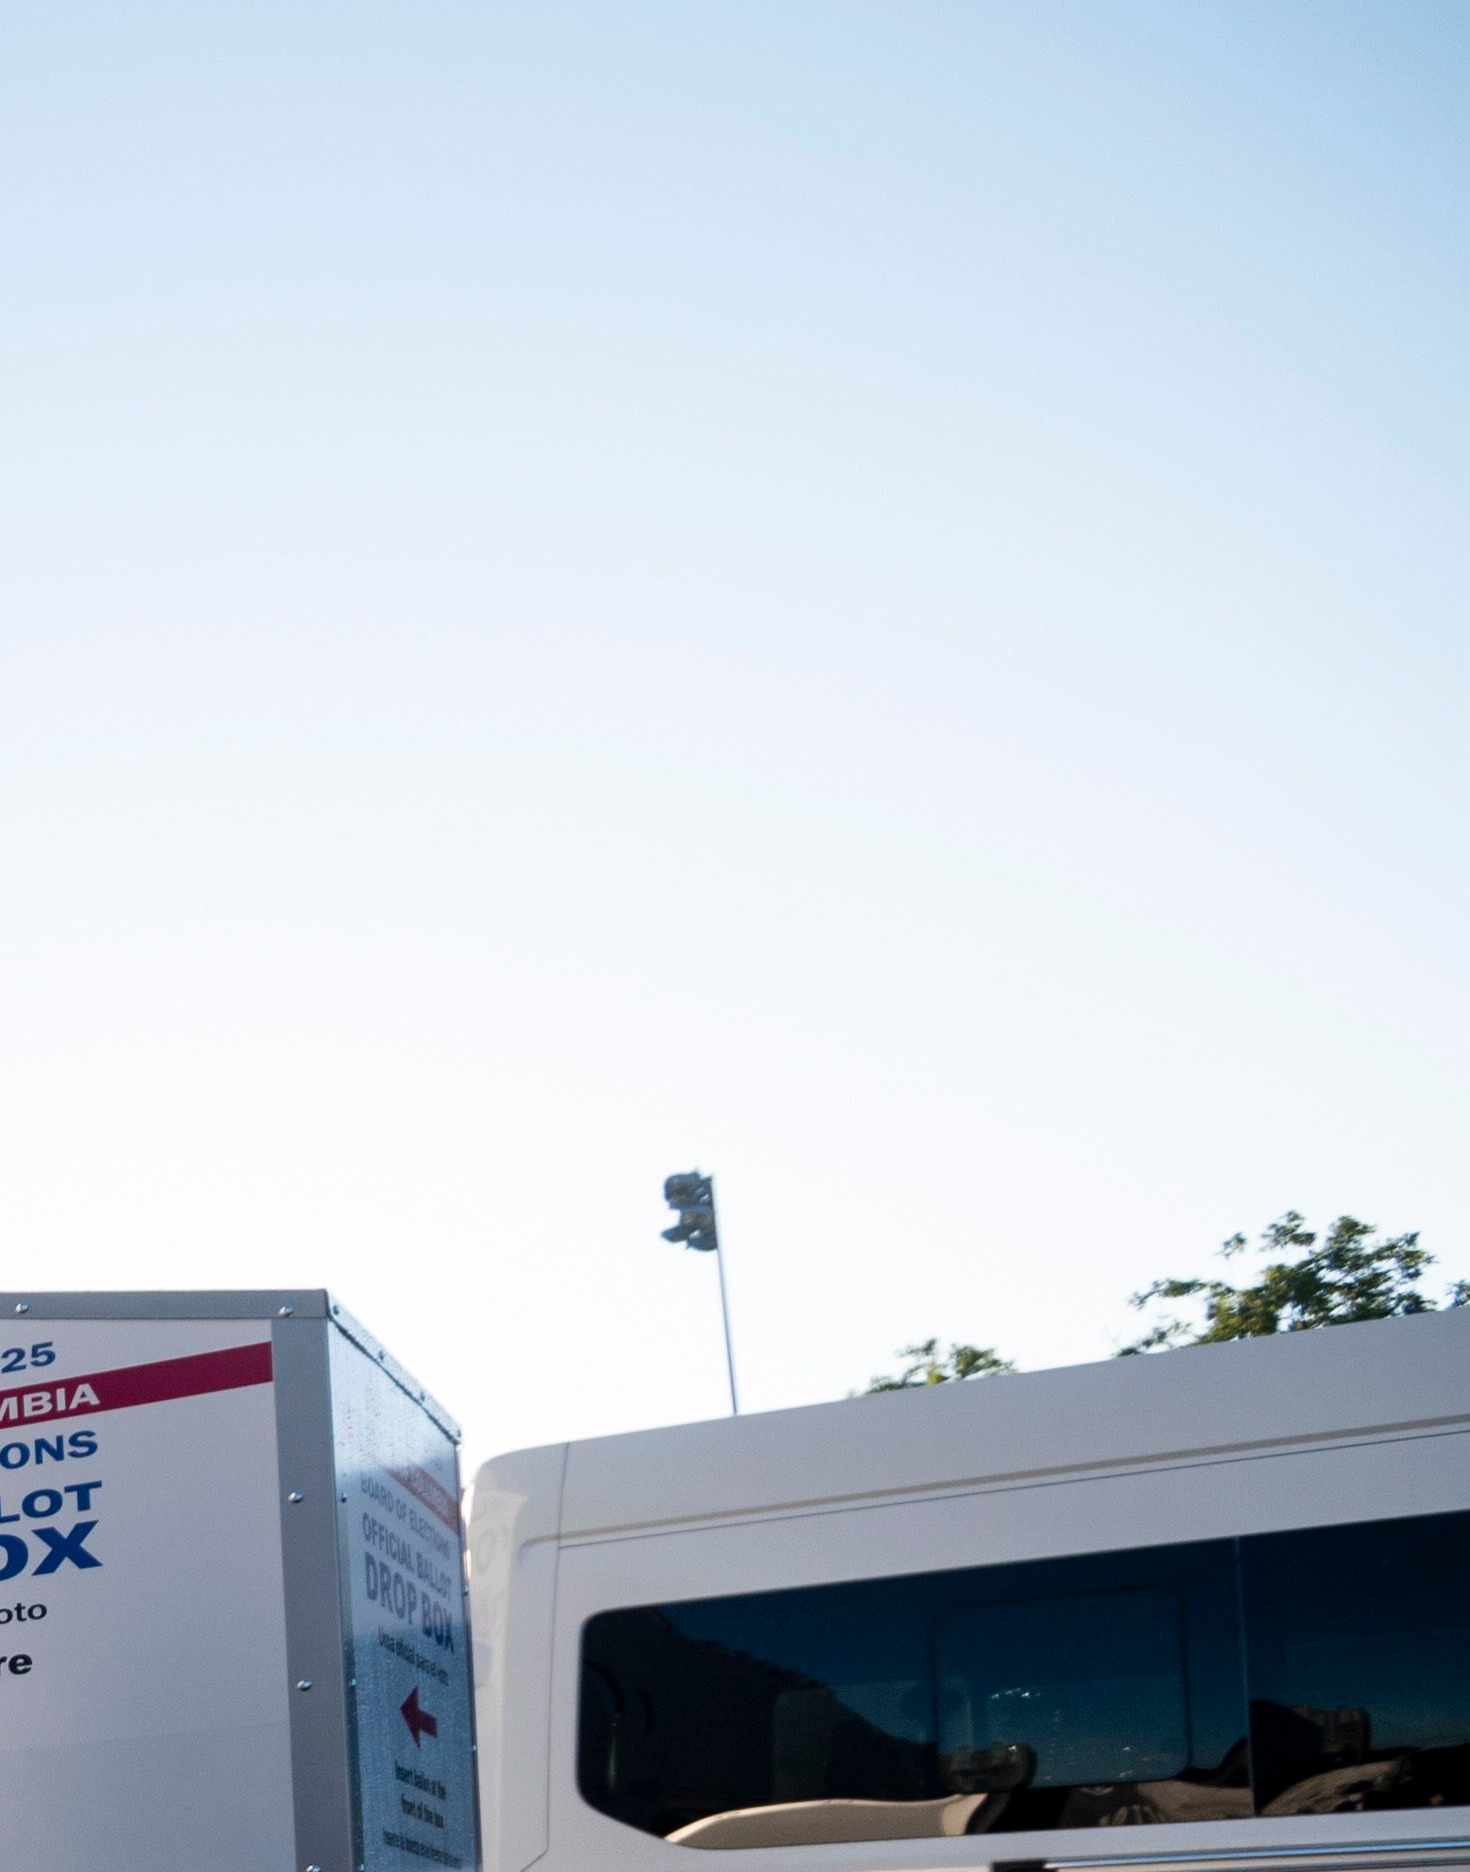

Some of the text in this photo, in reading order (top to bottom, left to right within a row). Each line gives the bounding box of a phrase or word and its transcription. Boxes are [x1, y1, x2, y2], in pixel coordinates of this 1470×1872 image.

[361, 1512, 452, 1603] OFFICIAL BALLOT
[365, 1551, 455, 1655] DROP BOX
